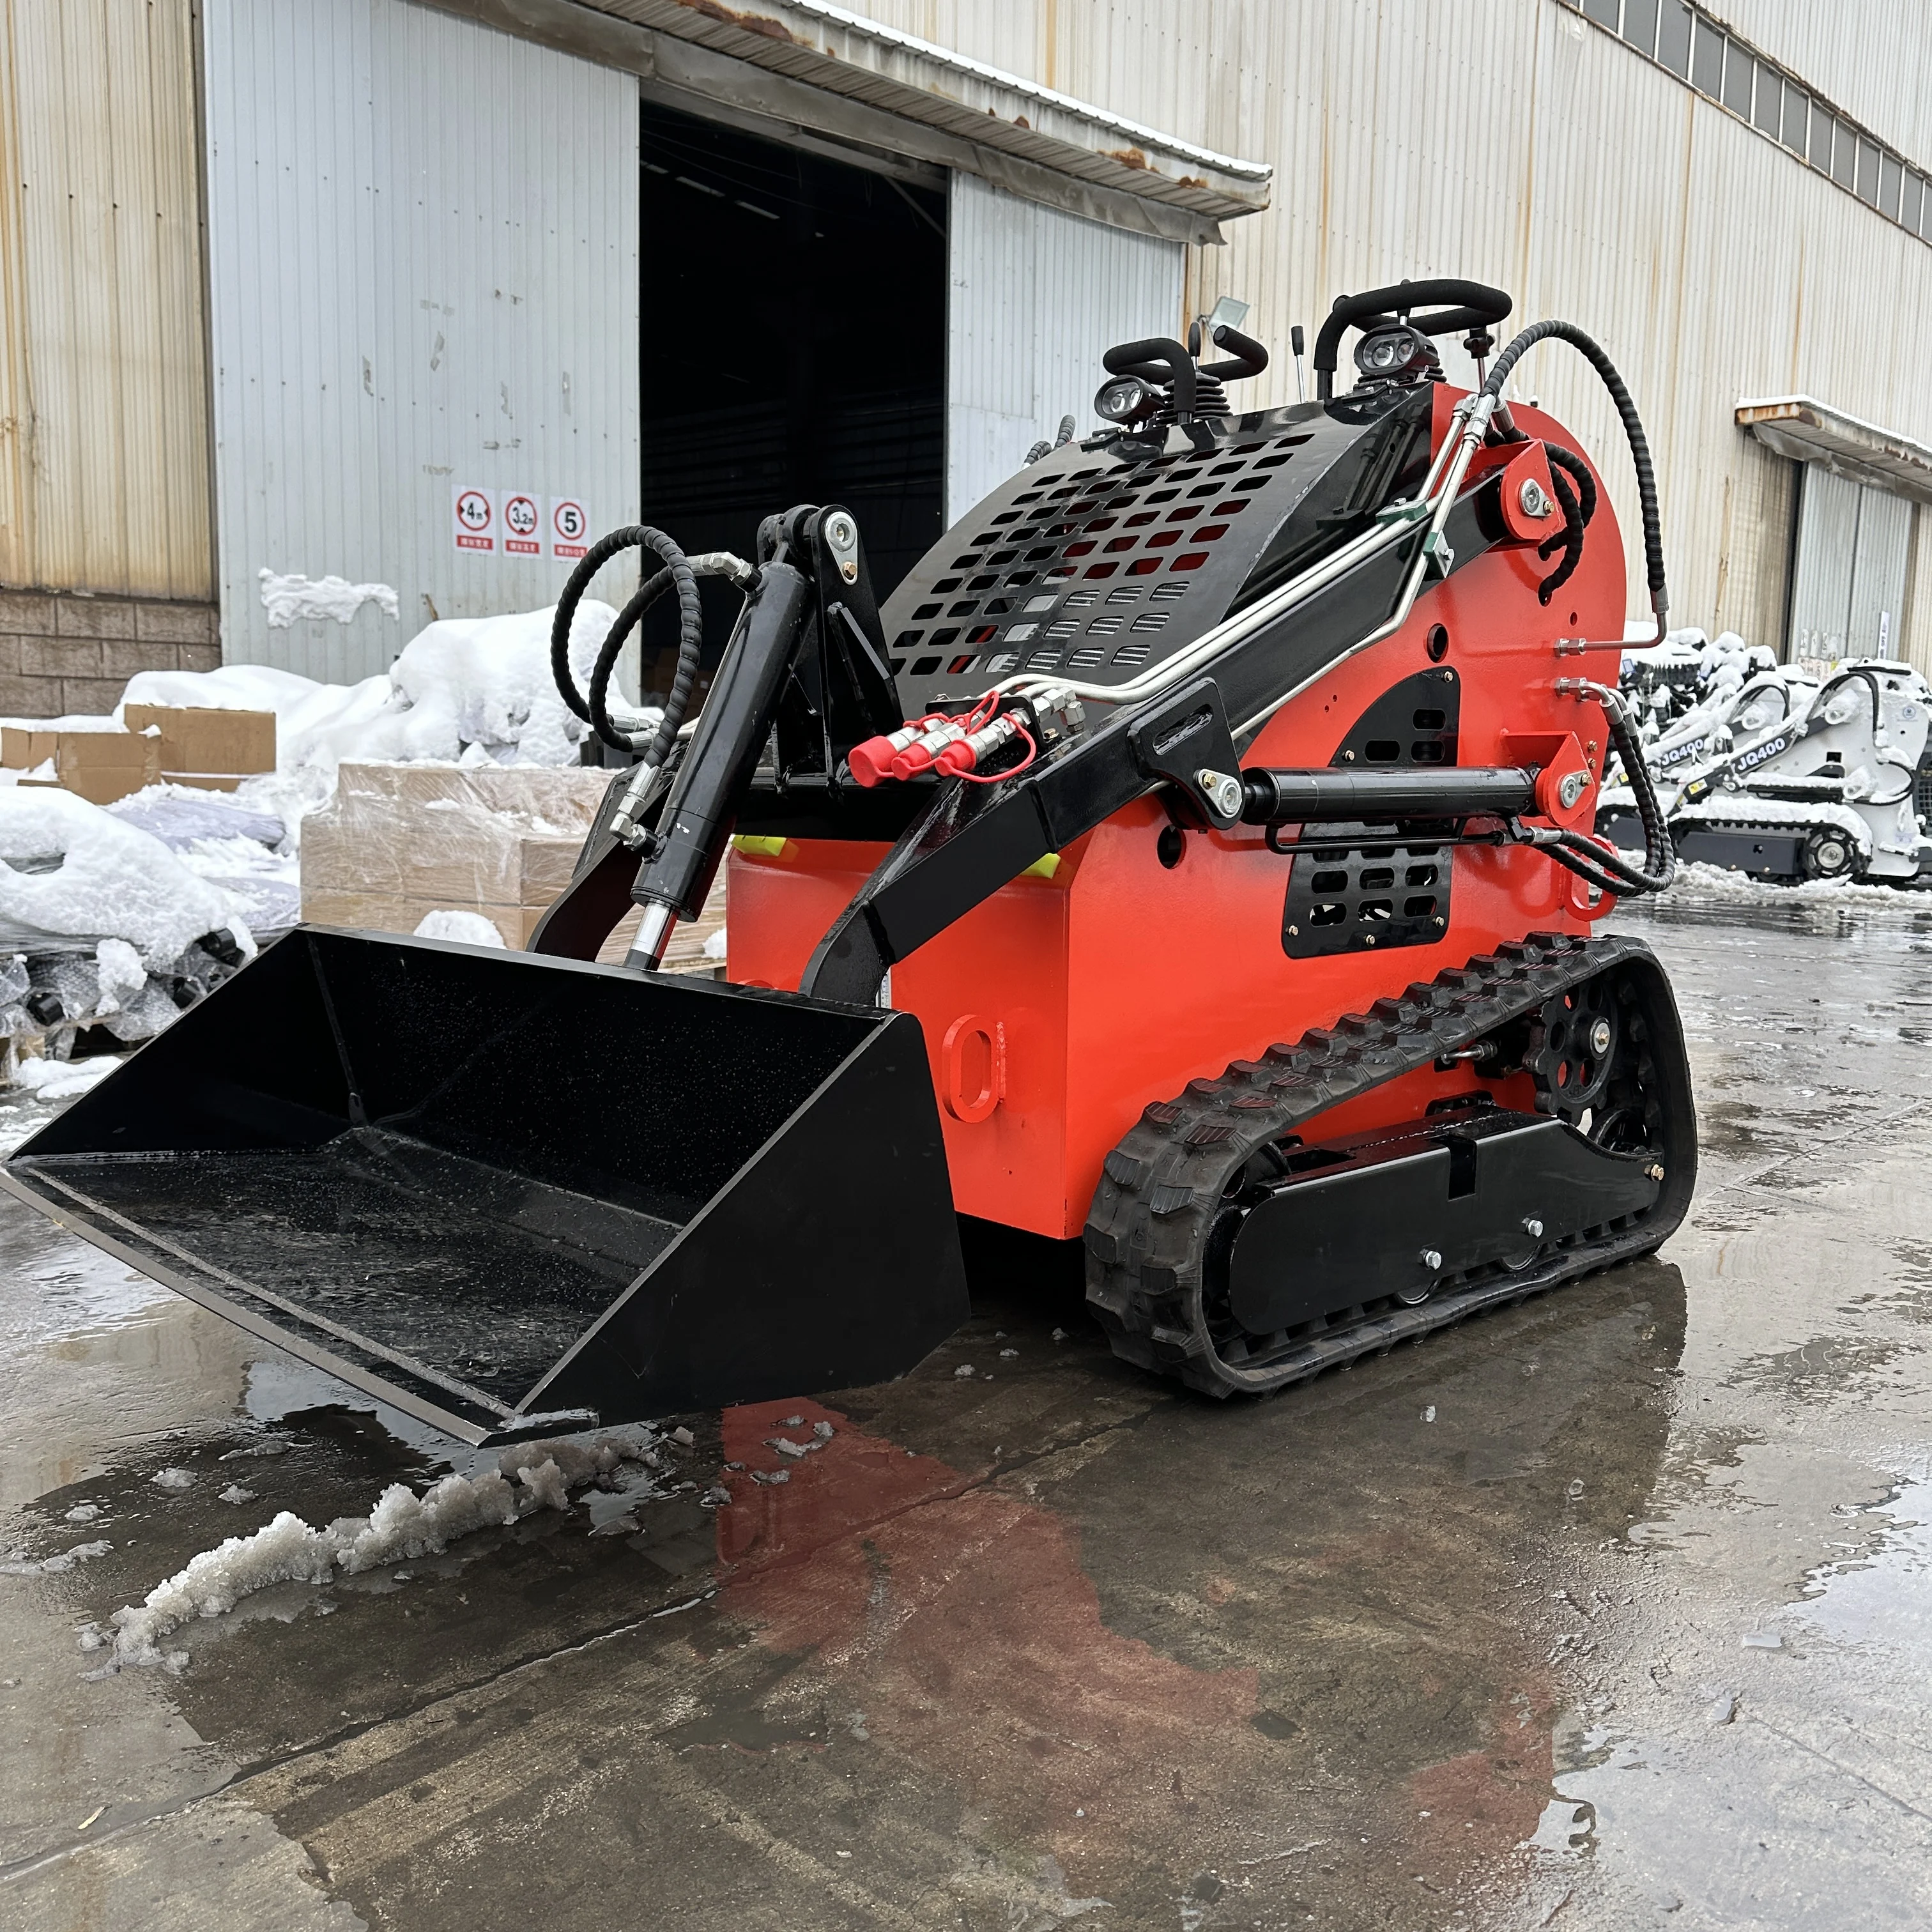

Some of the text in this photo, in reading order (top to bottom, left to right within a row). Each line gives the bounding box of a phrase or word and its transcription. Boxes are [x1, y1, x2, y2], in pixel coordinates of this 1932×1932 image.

[564, 511, 578, 533] 5
[1662, 739, 1705, 766] JQ400
[1738, 737, 1786, 770] JQ400
